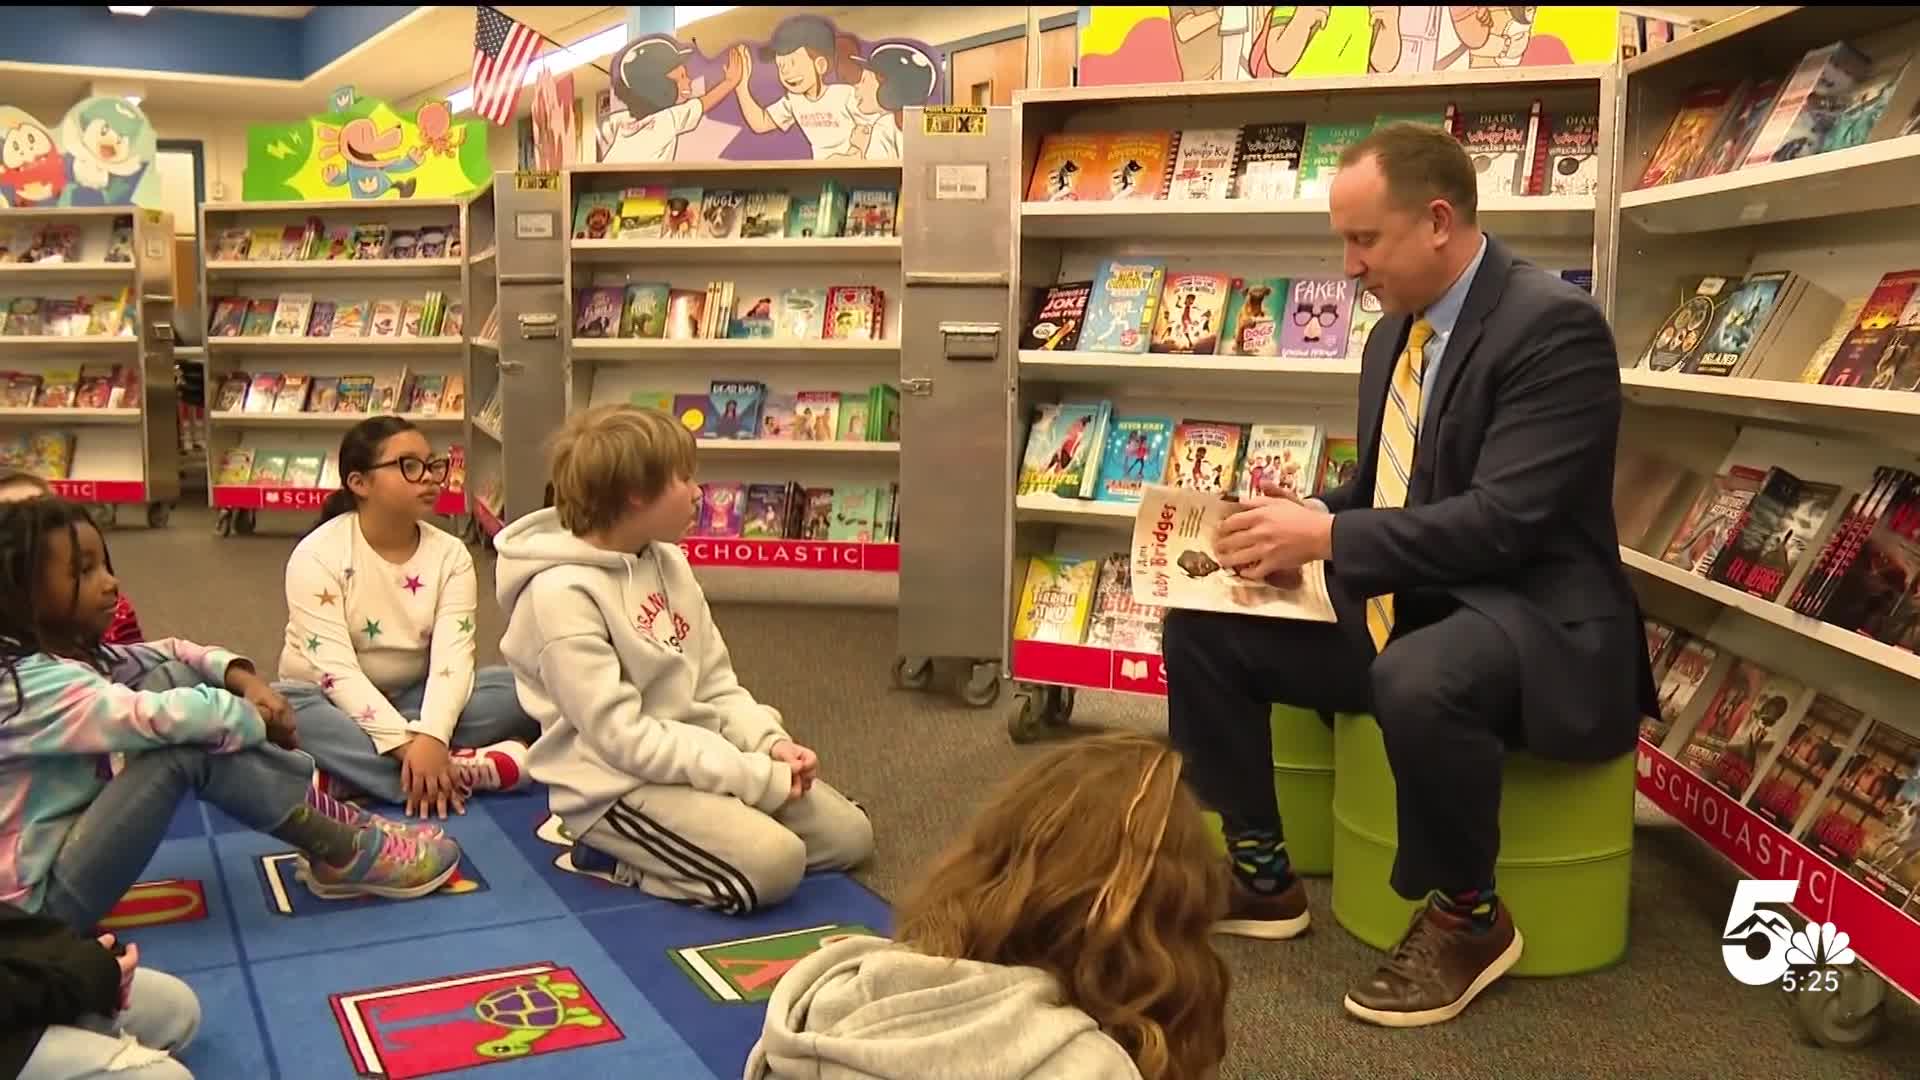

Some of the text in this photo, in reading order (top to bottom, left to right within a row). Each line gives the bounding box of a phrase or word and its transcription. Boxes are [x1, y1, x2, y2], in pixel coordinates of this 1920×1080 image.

[1043, 296, 1088, 312] JOKE
[1294, 280, 1346, 302] FAKER
[1150, 503, 1177, 567] Bridges
[1655, 763, 1827, 904] SCHOLASTIC
